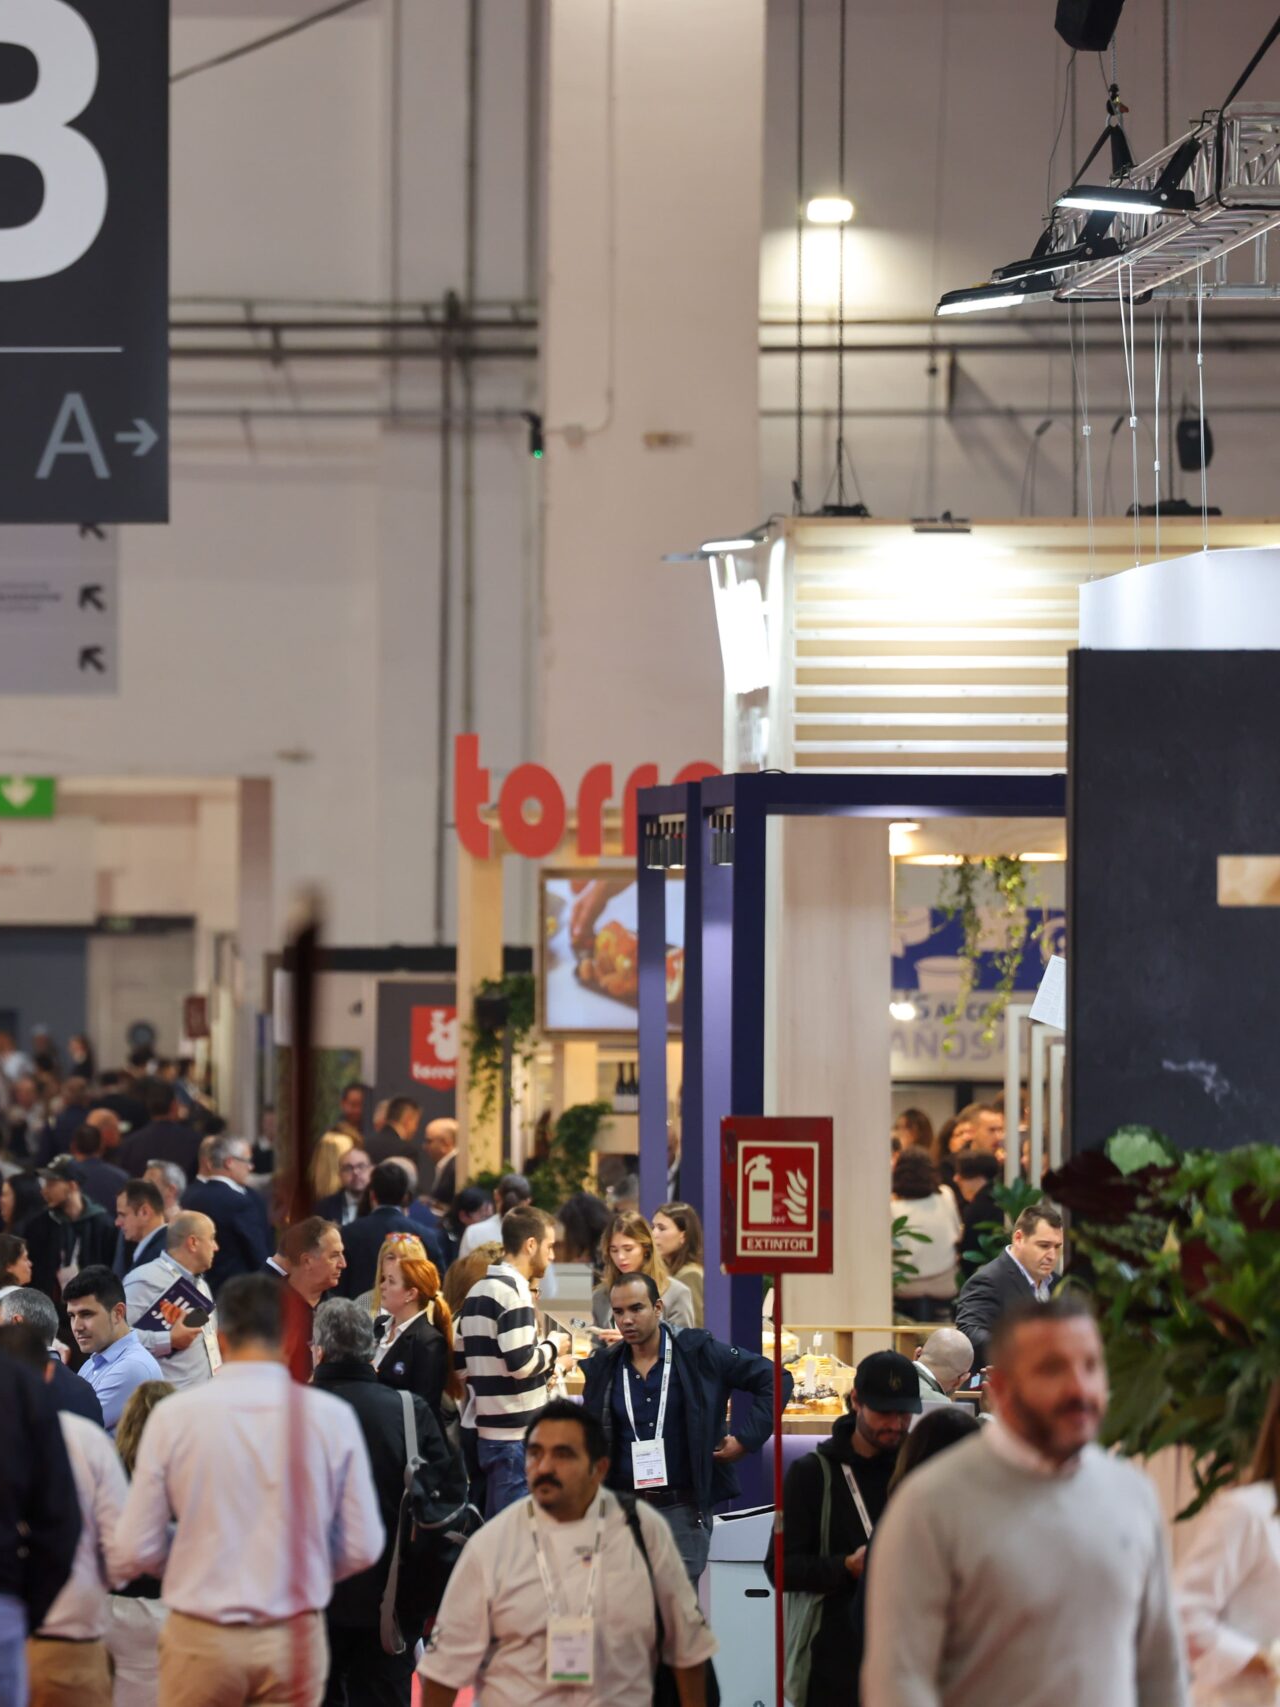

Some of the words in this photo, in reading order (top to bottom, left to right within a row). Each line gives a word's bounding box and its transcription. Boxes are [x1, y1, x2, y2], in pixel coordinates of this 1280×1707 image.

[35, 392, 111, 480] A
[455, 732, 722, 860] torr
[746, 1238, 808, 1250] EXTINTOR
